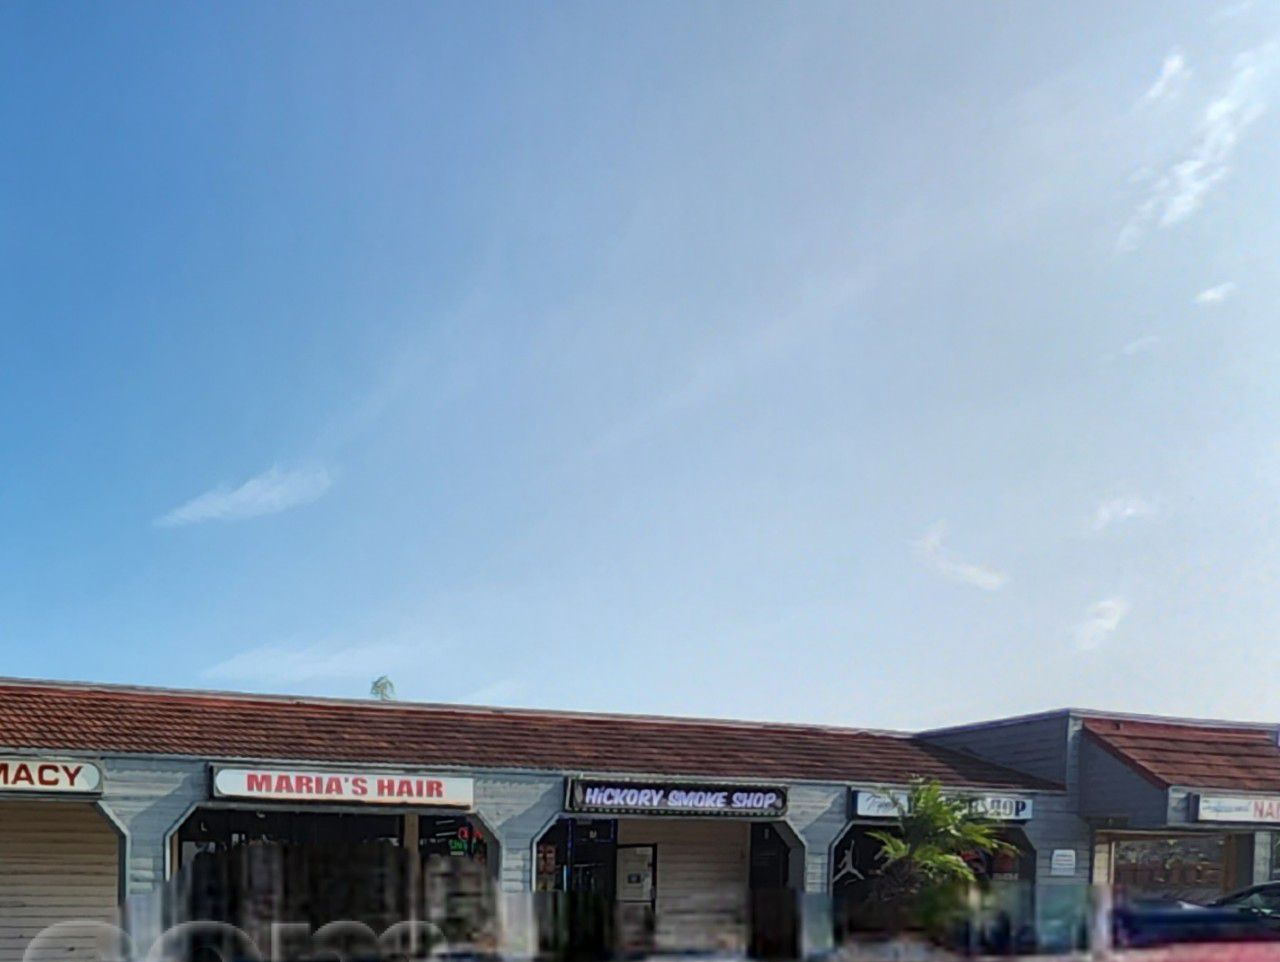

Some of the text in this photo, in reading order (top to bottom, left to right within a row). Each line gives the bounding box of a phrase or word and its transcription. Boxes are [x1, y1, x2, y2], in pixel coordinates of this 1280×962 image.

[246, 774, 444, 799] MARIA'S HAIR
[666, 788, 728, 809] SMOKE
[731, 791, 777, 809] SHOP
